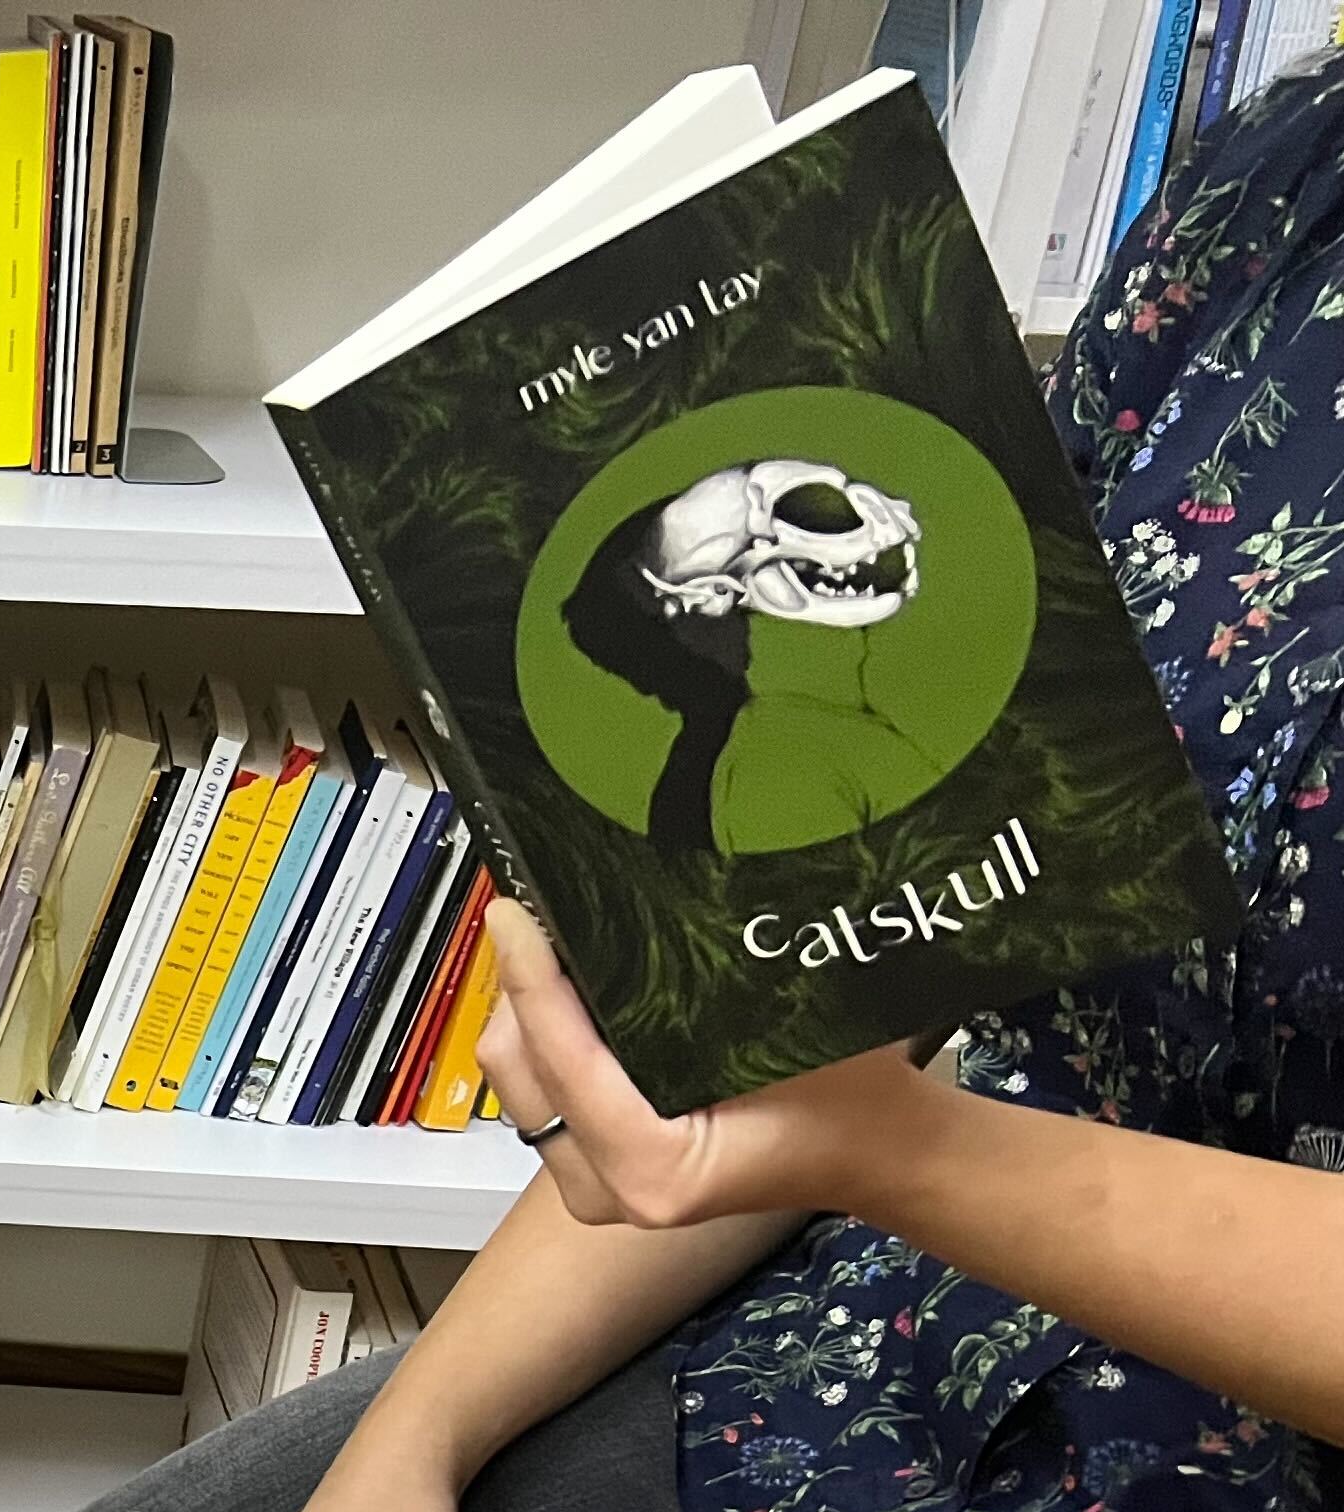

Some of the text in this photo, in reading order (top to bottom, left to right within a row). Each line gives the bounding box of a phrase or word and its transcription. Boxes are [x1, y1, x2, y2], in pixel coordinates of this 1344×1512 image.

[519, 344, 614, 411] myle
[622, 304, 695, 362] yan
[175, 754, 228, 867] NO OTHER CITY
[346, 924, 364, 947] New
[355, 904, 372, 926] The
[331, 945, 355, 980] Village
[304, 1310, 330, 1385] JON COOPE
